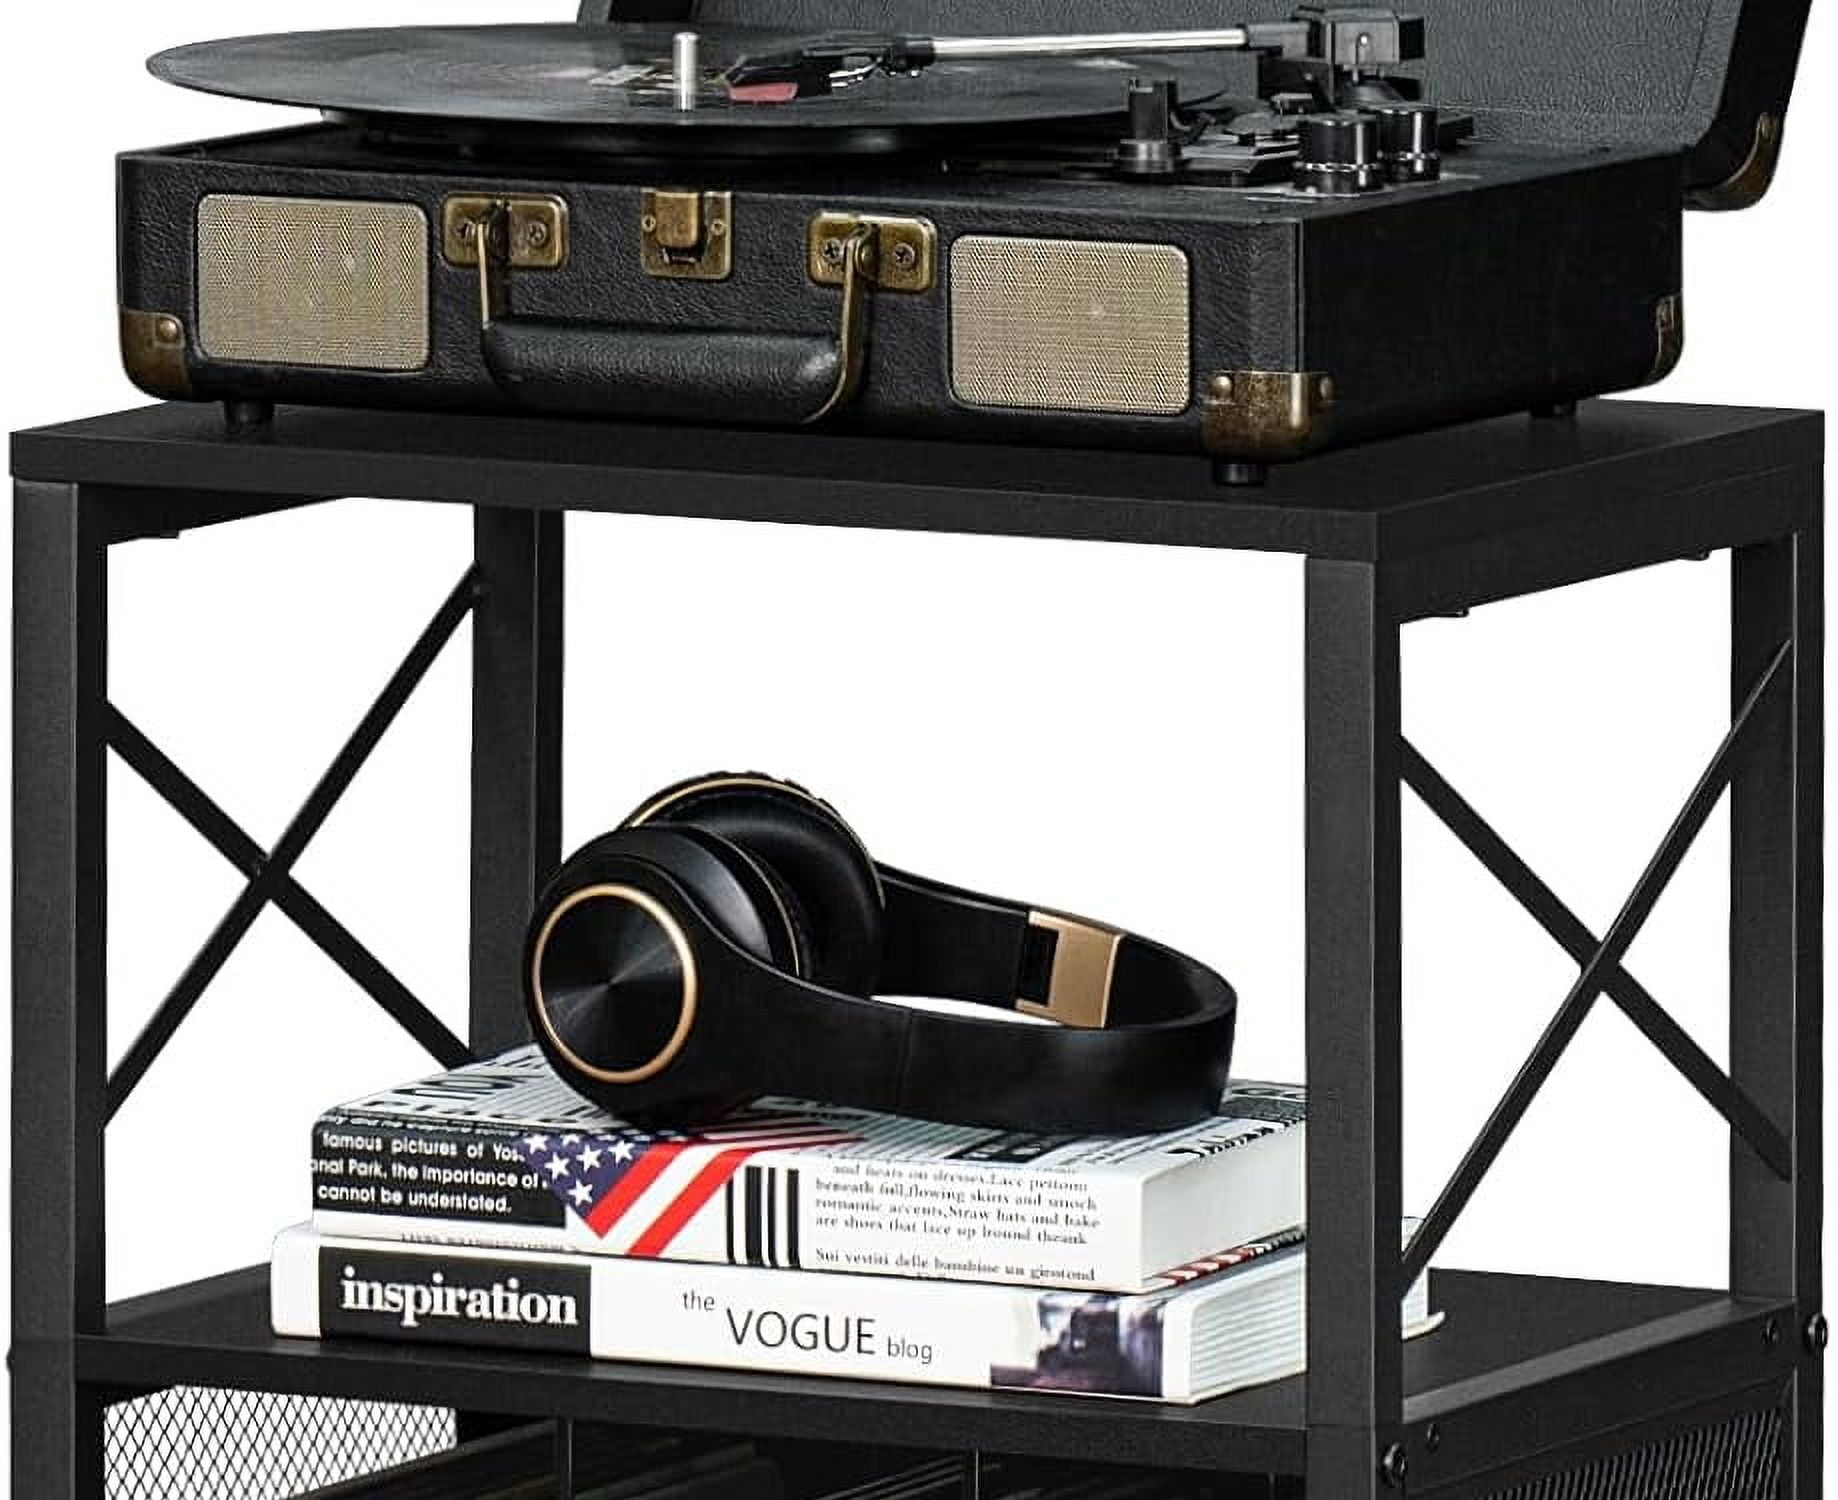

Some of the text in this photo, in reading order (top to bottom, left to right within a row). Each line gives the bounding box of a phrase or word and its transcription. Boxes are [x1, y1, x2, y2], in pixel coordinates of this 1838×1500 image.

[323, 1132, 382, 1151] famous
[391, 1136, 457, 1157] pictures
[467, 1142, 483, 1158] of
[392, 1163, 418, 1180] the
[422, 1164, 518, 1188] importance
[317, 1184, 512, 1214] cannot be understated.
[816, 1199, 880, 1213] romantic
[997, 1208, 1026, 1223] hats
[1031, 1212, 1058, 1225] and
[1015, 1193, 1041, 1206] and
[816, 1217, 838, 1228] are
[889, 1218, 917, 1232] that
[341, 1266, 580, 1330] inspiration
[682, 1290, 934, 1365] the VOGUE blog
